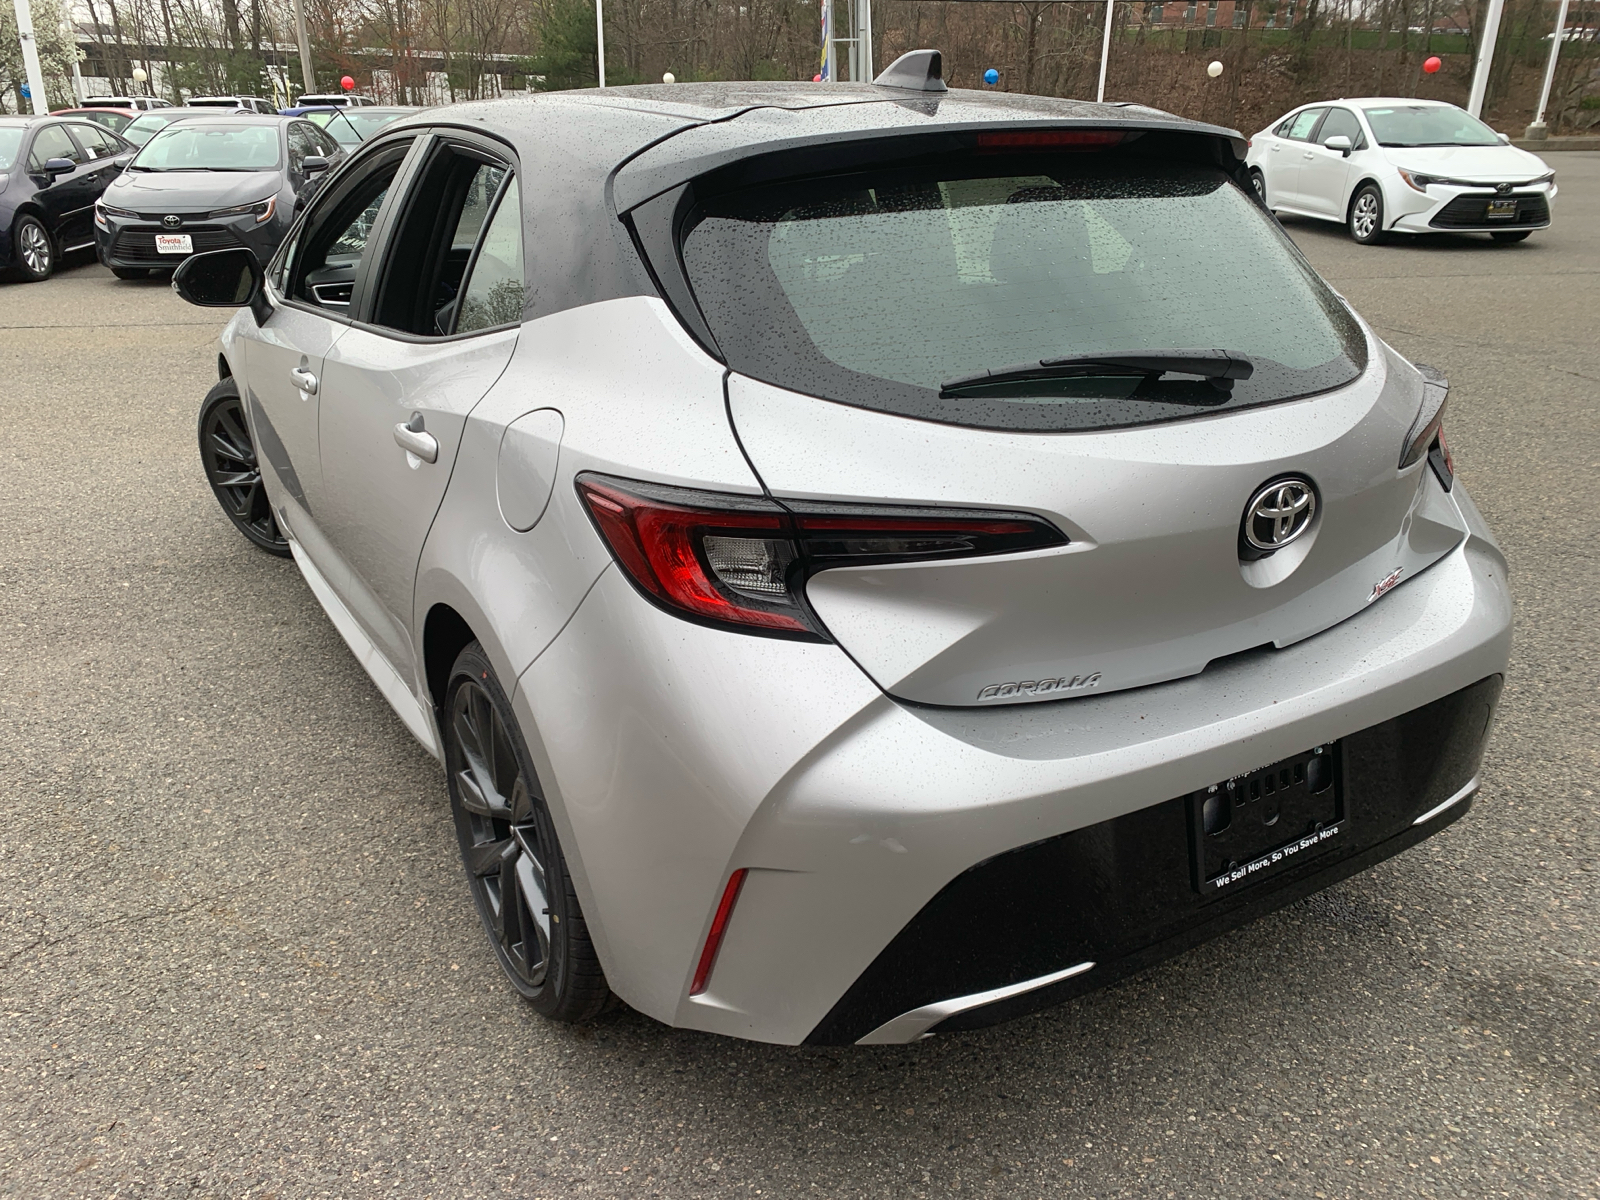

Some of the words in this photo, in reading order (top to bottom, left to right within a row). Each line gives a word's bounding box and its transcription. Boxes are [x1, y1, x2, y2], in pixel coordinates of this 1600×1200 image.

[977, 671, 1102, 701] COROLLA
[1216, 876, 1230, 888] We
[1231, 868, 1247, 881] Sell
[1248, 859, 1271, 873] More,
[1271, 852, 1282, 862] So
[1283, 844, 1299, 857] You
[1300, 836, 1318, 849] Save
[1319, 826, 1339, 840] More
